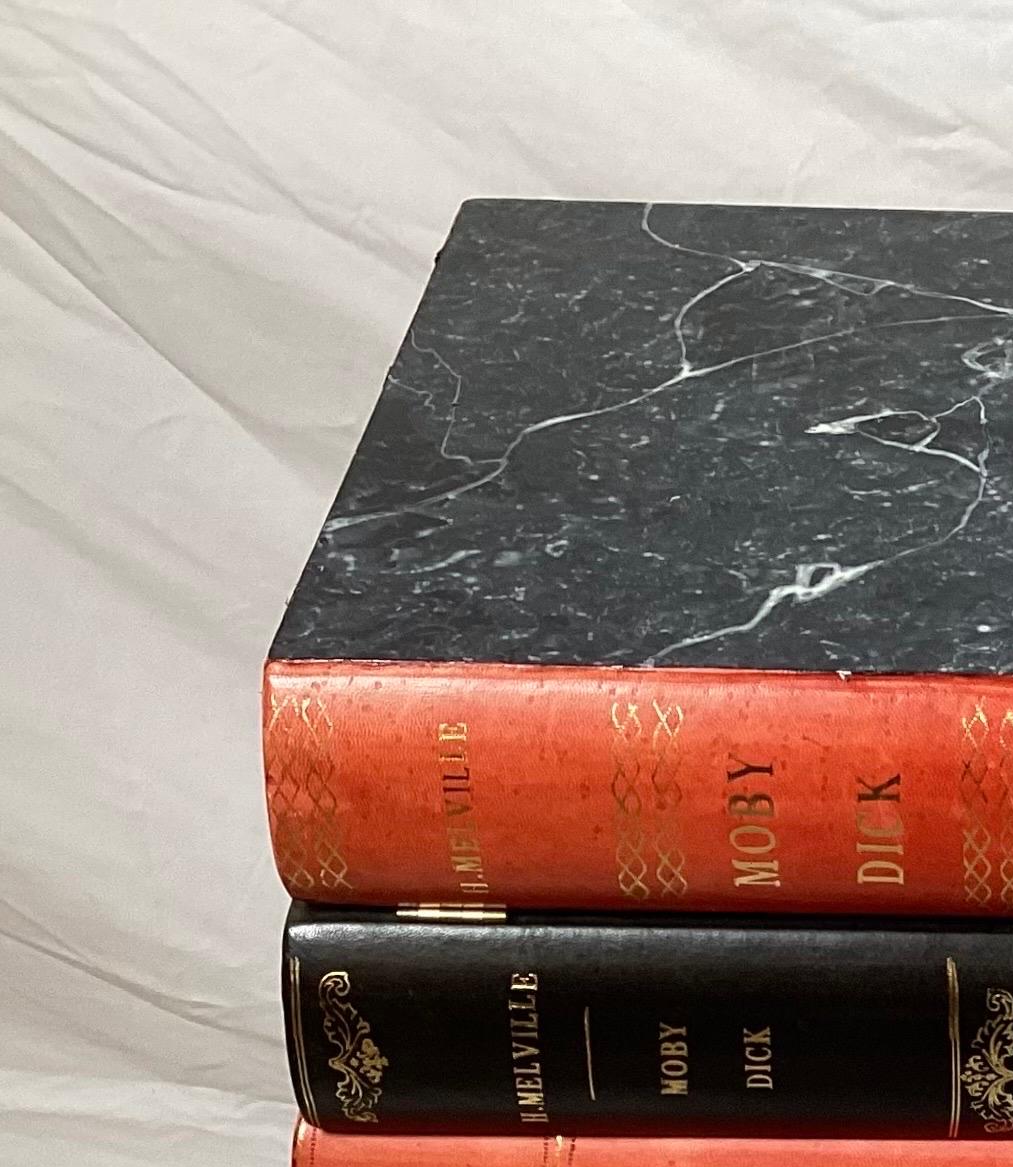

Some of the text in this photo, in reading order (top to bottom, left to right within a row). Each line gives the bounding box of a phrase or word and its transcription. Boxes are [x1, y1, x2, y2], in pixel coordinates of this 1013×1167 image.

[727, 752, 781, 887] MOBY
[855, 773, 905, 885] DICK
[508, 972, 549, 1123] H.MELVILLE
[659, 1022, 688, 1095] MOBY
[743, 1025, 773, 1090] DICK
